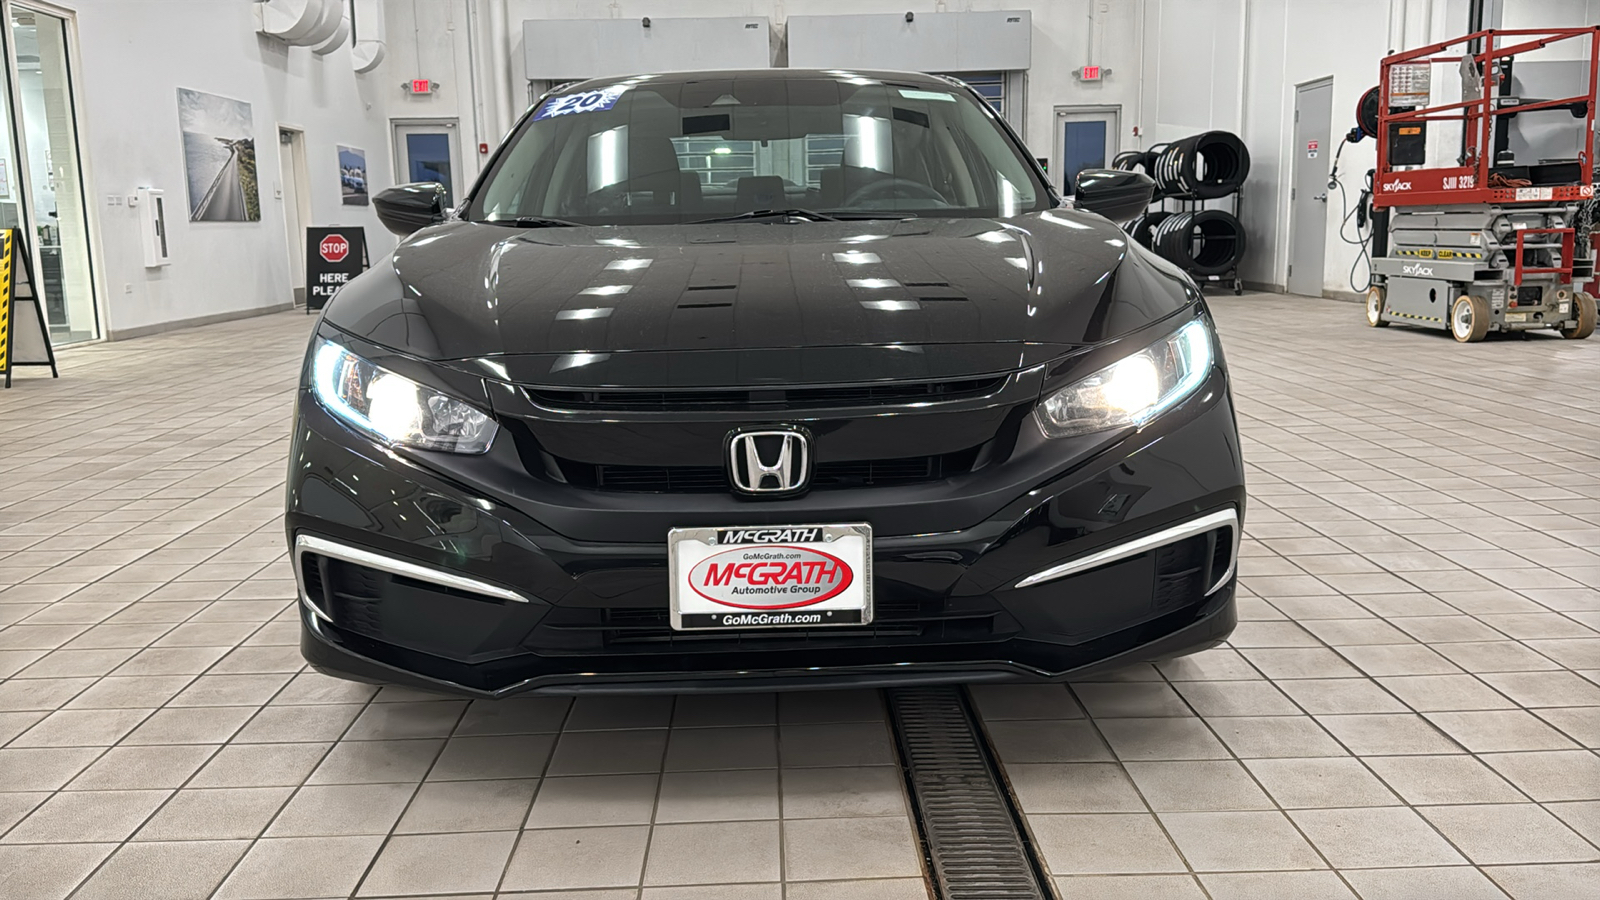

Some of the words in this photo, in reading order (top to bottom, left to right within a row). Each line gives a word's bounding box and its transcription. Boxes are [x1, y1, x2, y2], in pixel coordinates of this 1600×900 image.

[1084, 66, 1099, 79] EXIT
[413, 80, 429, 93] EXIT
[556, 93, 603, 111] 20
[1383, 178, 1412, 193] SKYJACK
[322, 243, 347, 254] STOP
[1402, 263, 1434, 276] SKYJACK
[320, 273, 349, 283] HERE
[743, 552, 802, 560] GoMcGrath.com
[731, 586, 788, 595] Automotive
[790, 585, 821, 595] Group
[722, 614, 822, 625] GoMcGrath.com
